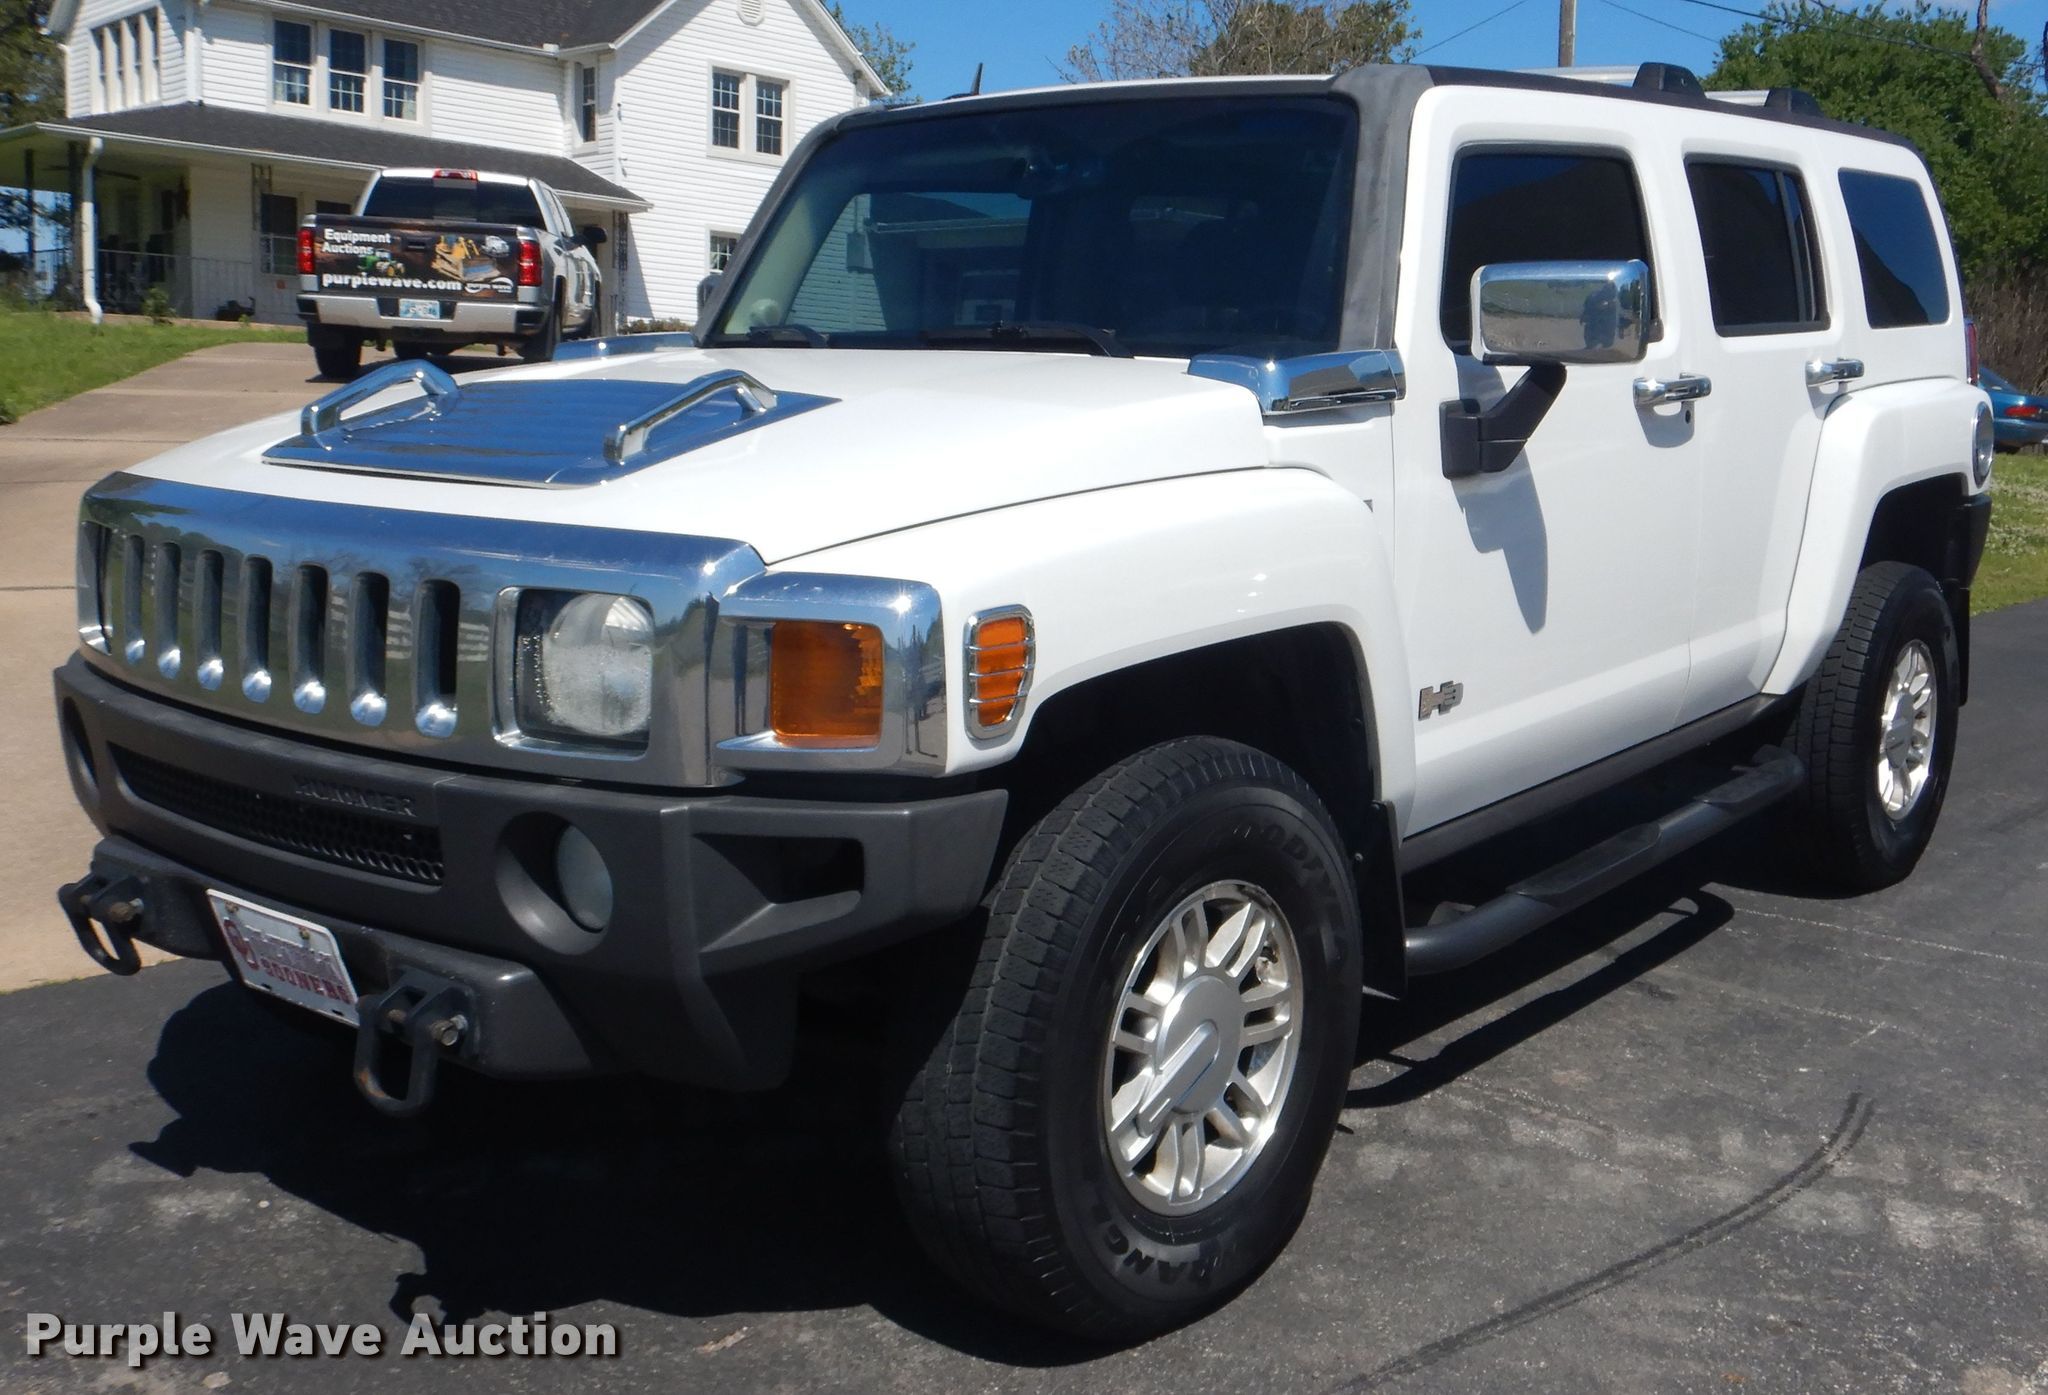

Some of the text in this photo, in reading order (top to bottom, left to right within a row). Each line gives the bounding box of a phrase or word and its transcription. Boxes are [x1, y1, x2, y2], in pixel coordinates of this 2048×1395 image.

[324, 228, 391, 243] Equipment
[322, 241, 374, 255] Auctions
[322, 272, 462, 291] purplewave.com
[1418, 680, 1464, 721] H3
